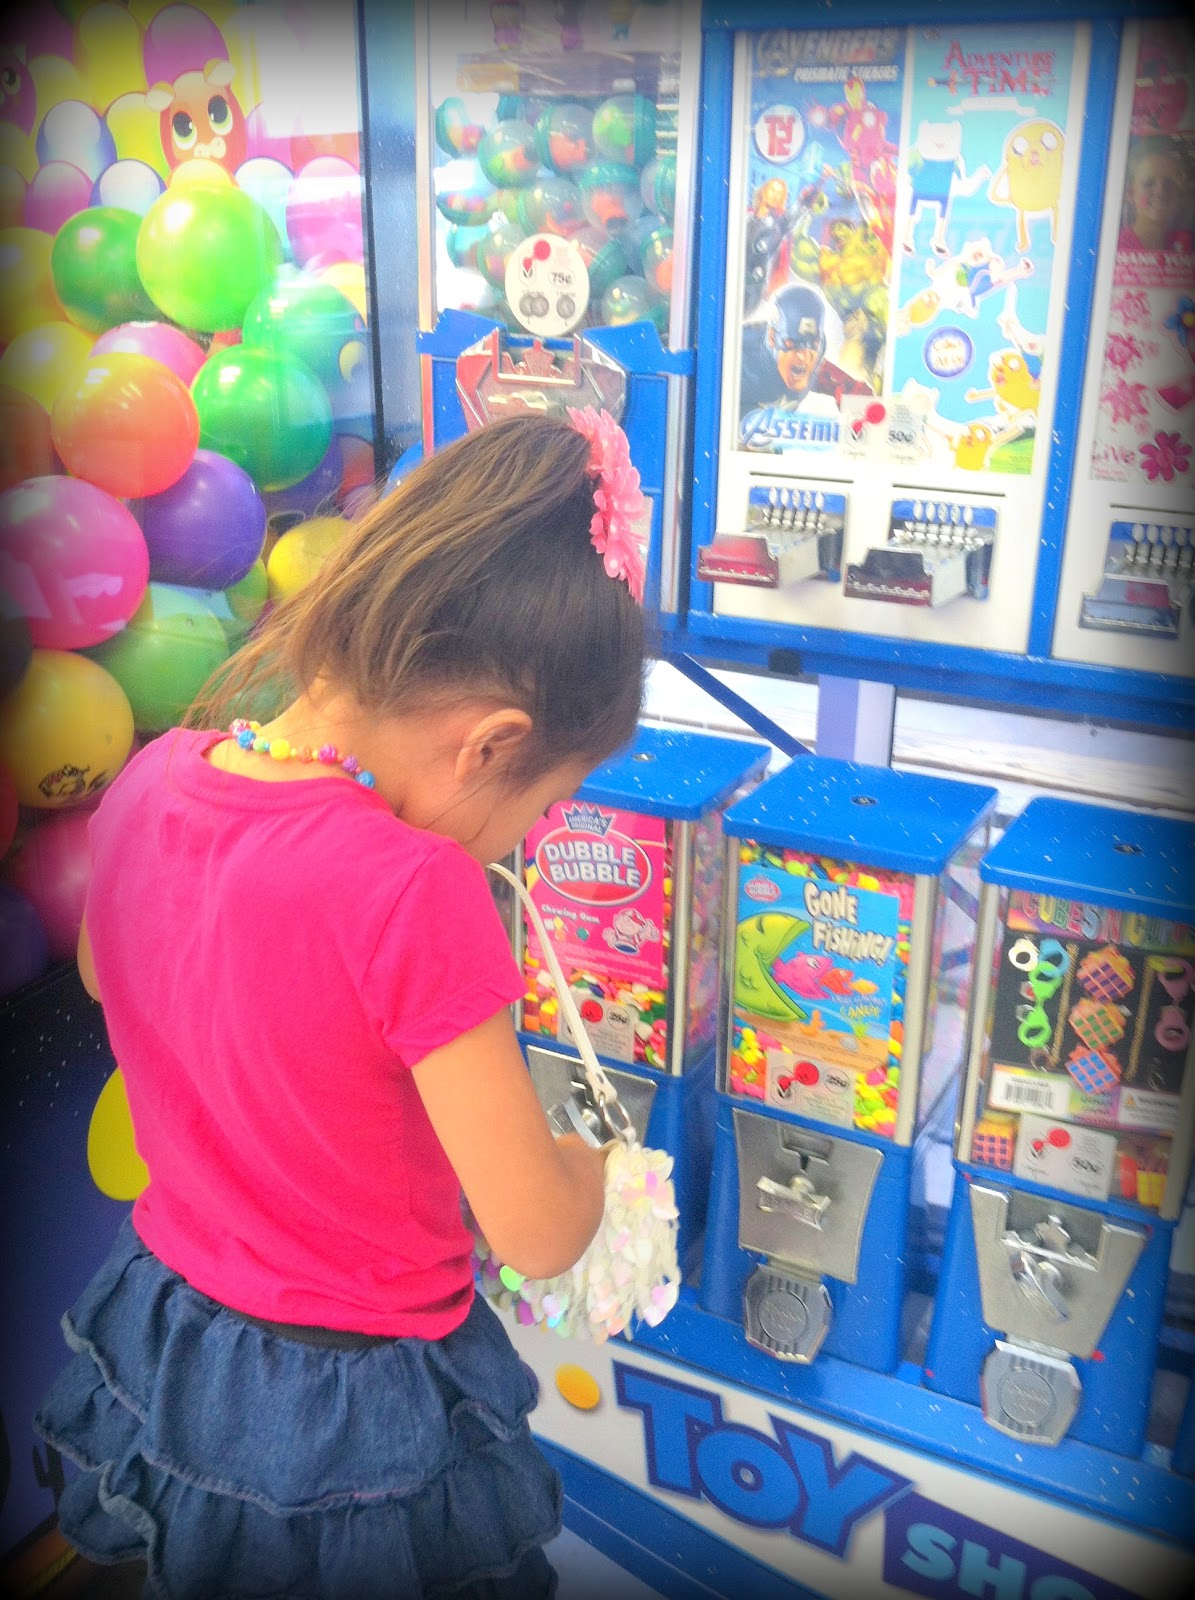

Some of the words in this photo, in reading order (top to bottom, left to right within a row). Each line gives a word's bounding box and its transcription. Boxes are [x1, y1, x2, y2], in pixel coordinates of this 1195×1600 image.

[941, 40, 1057, 75] ADVENTURE
[962, 67, 1053, 96] TIME
[740, 407, 839, 446] ASSEM
[544, 841, 636, 868] DUBBLE
[549, 861, 641, 889] BUBBLE
[541, 904, 578, 921] Chewing
[579, 912, 600, 925] Gum
[803, 880, 858, 926] GONE
[612, 1358, 916, 1562] TOY
